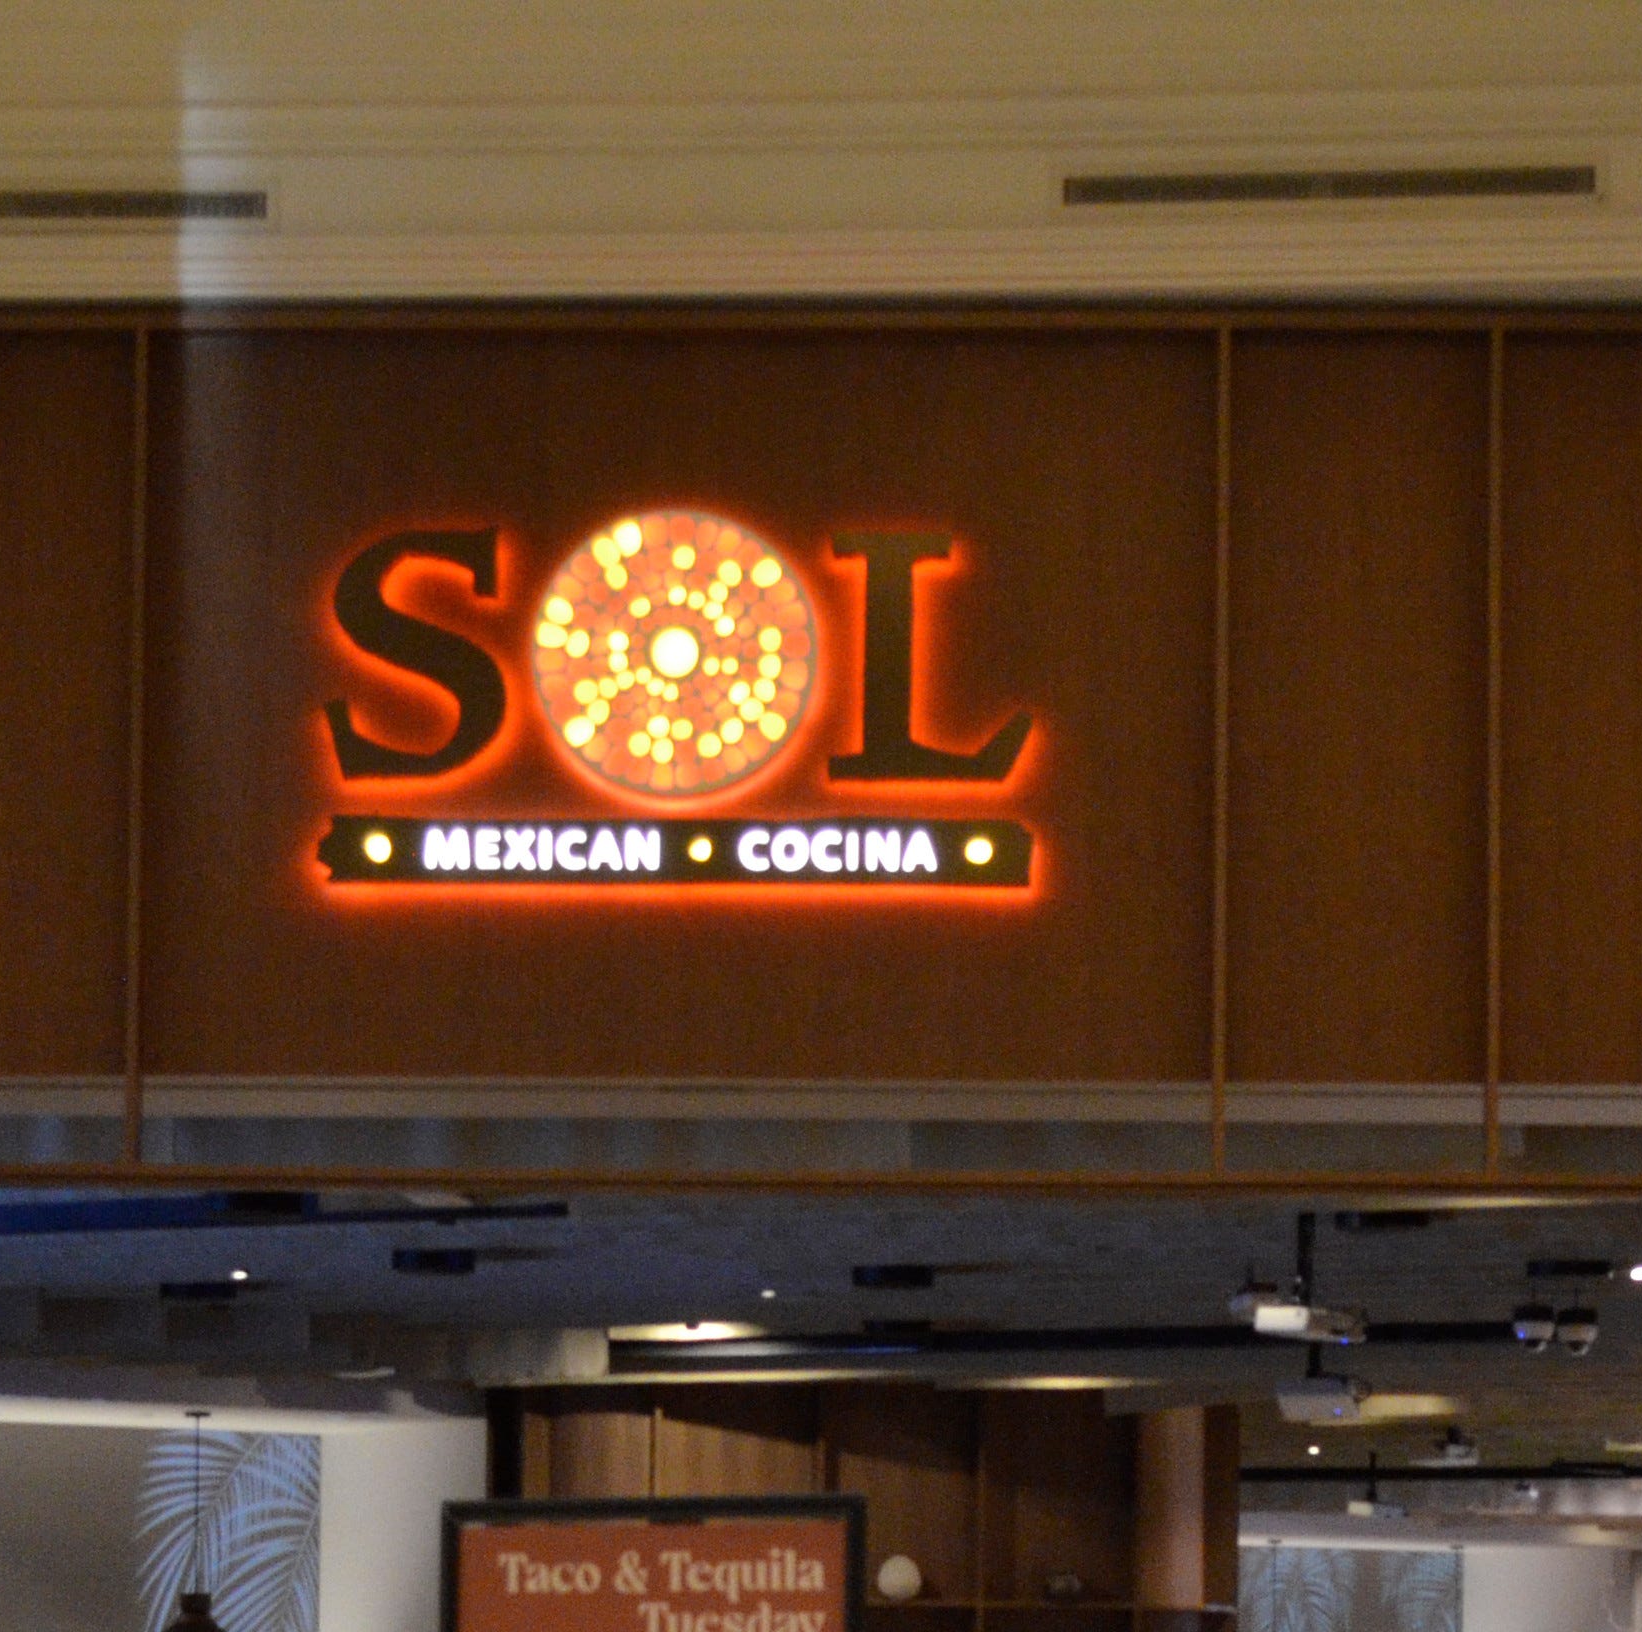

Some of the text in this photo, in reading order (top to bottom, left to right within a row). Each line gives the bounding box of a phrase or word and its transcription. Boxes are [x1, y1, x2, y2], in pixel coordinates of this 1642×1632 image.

[324, 510, 1033, 798] SOL
[423, 828, 939, 873] MEXICAN COCINA
[499, 1548, 825, 1601] Taco & Tequila
